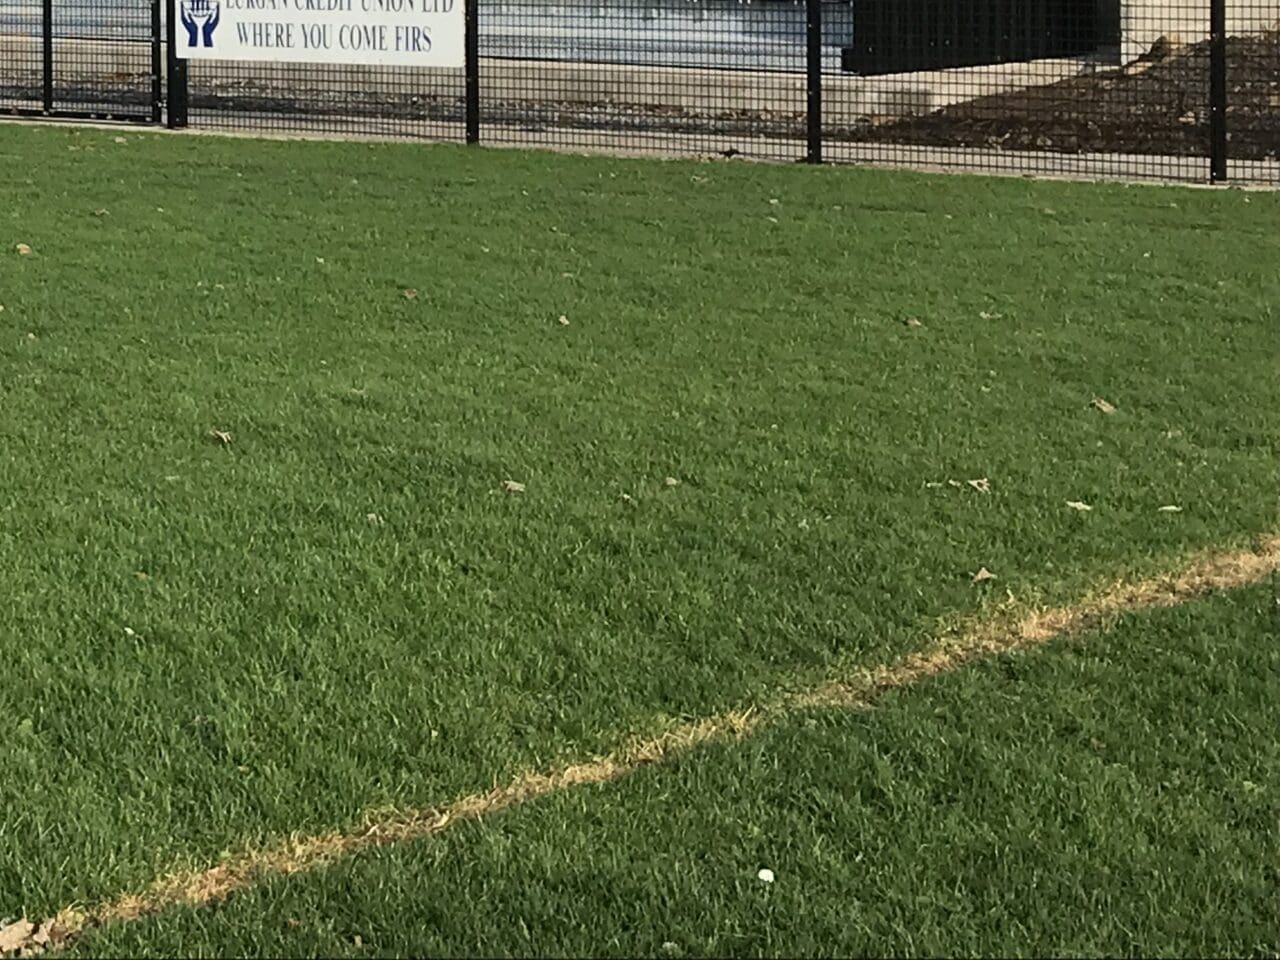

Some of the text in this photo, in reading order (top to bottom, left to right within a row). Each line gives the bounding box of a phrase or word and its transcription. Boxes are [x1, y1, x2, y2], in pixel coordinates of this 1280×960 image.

[236, 21, 433, 53] WHERE YOU COME FIRS
